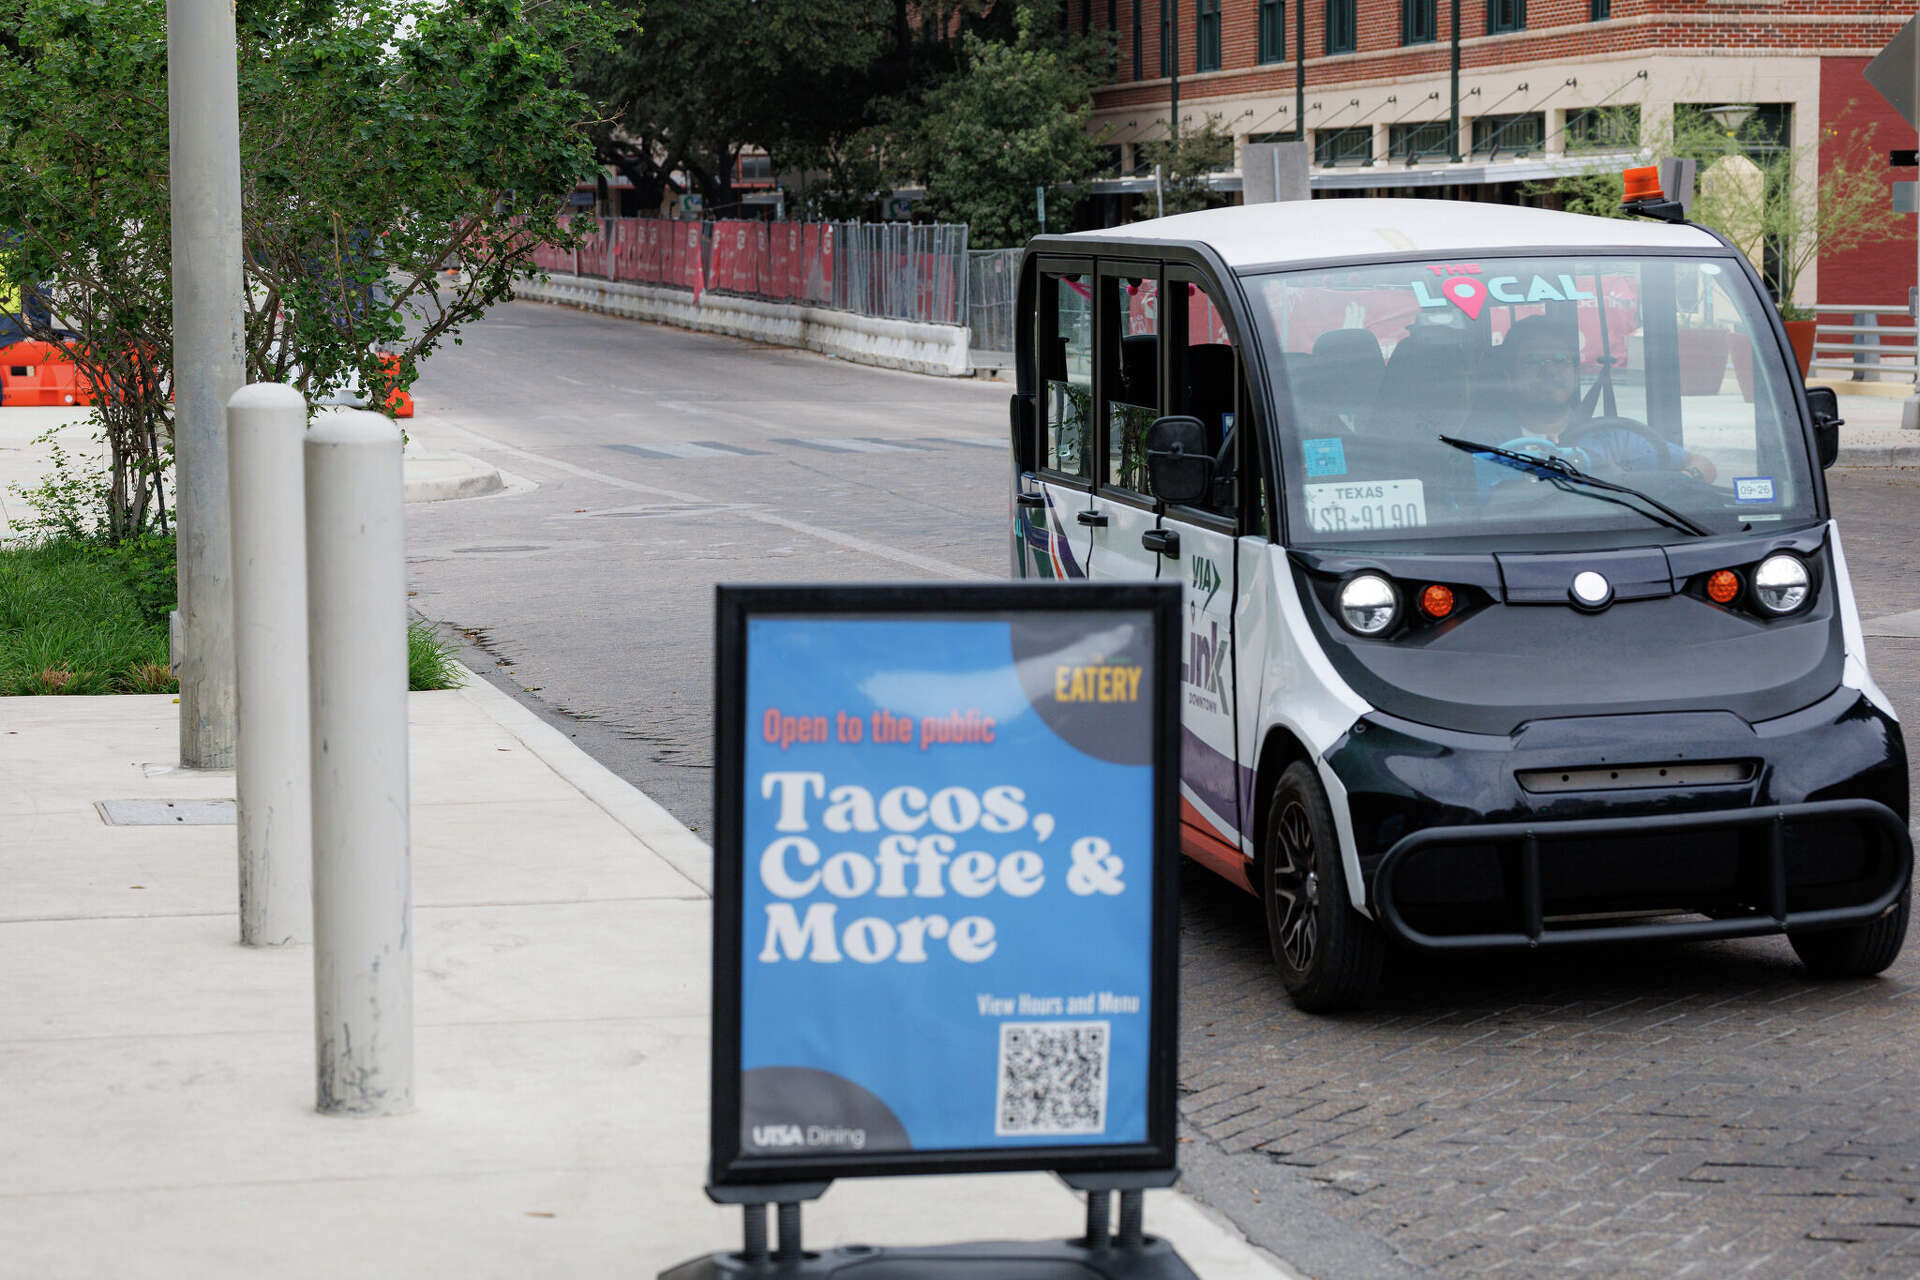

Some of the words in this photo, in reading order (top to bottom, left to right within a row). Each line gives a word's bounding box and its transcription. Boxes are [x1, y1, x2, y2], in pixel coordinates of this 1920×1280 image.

[1426, 263, 1483, 276] THE
[1411, 274, 1595, 320] LOCAL
[1336, 486, 1384, 499] TEXAS
[1193, 554, 1213, 592] VIA
[1055, 665, 1142, 702] EATERY
[763, 708, 829, 750] Open
[836, 711, 863, 743] to
[871, 709, 913, 743] the
[920, 709, 996, 750] public
[761, 771, 1055, 842] Tacos,
[760, 834, 1045, 898] Coffee
[1066, 836, 1125, 896] &
[758, 902, 997, 963] More
[977, 993, 1015, 1016] View
[1018, 993, 1063, 1016] Hours
[1067, 992, 1095, 1015] and
[1098, 991, 1140, 1014] Menu
[806, 1124, 866, 1150] Dining
